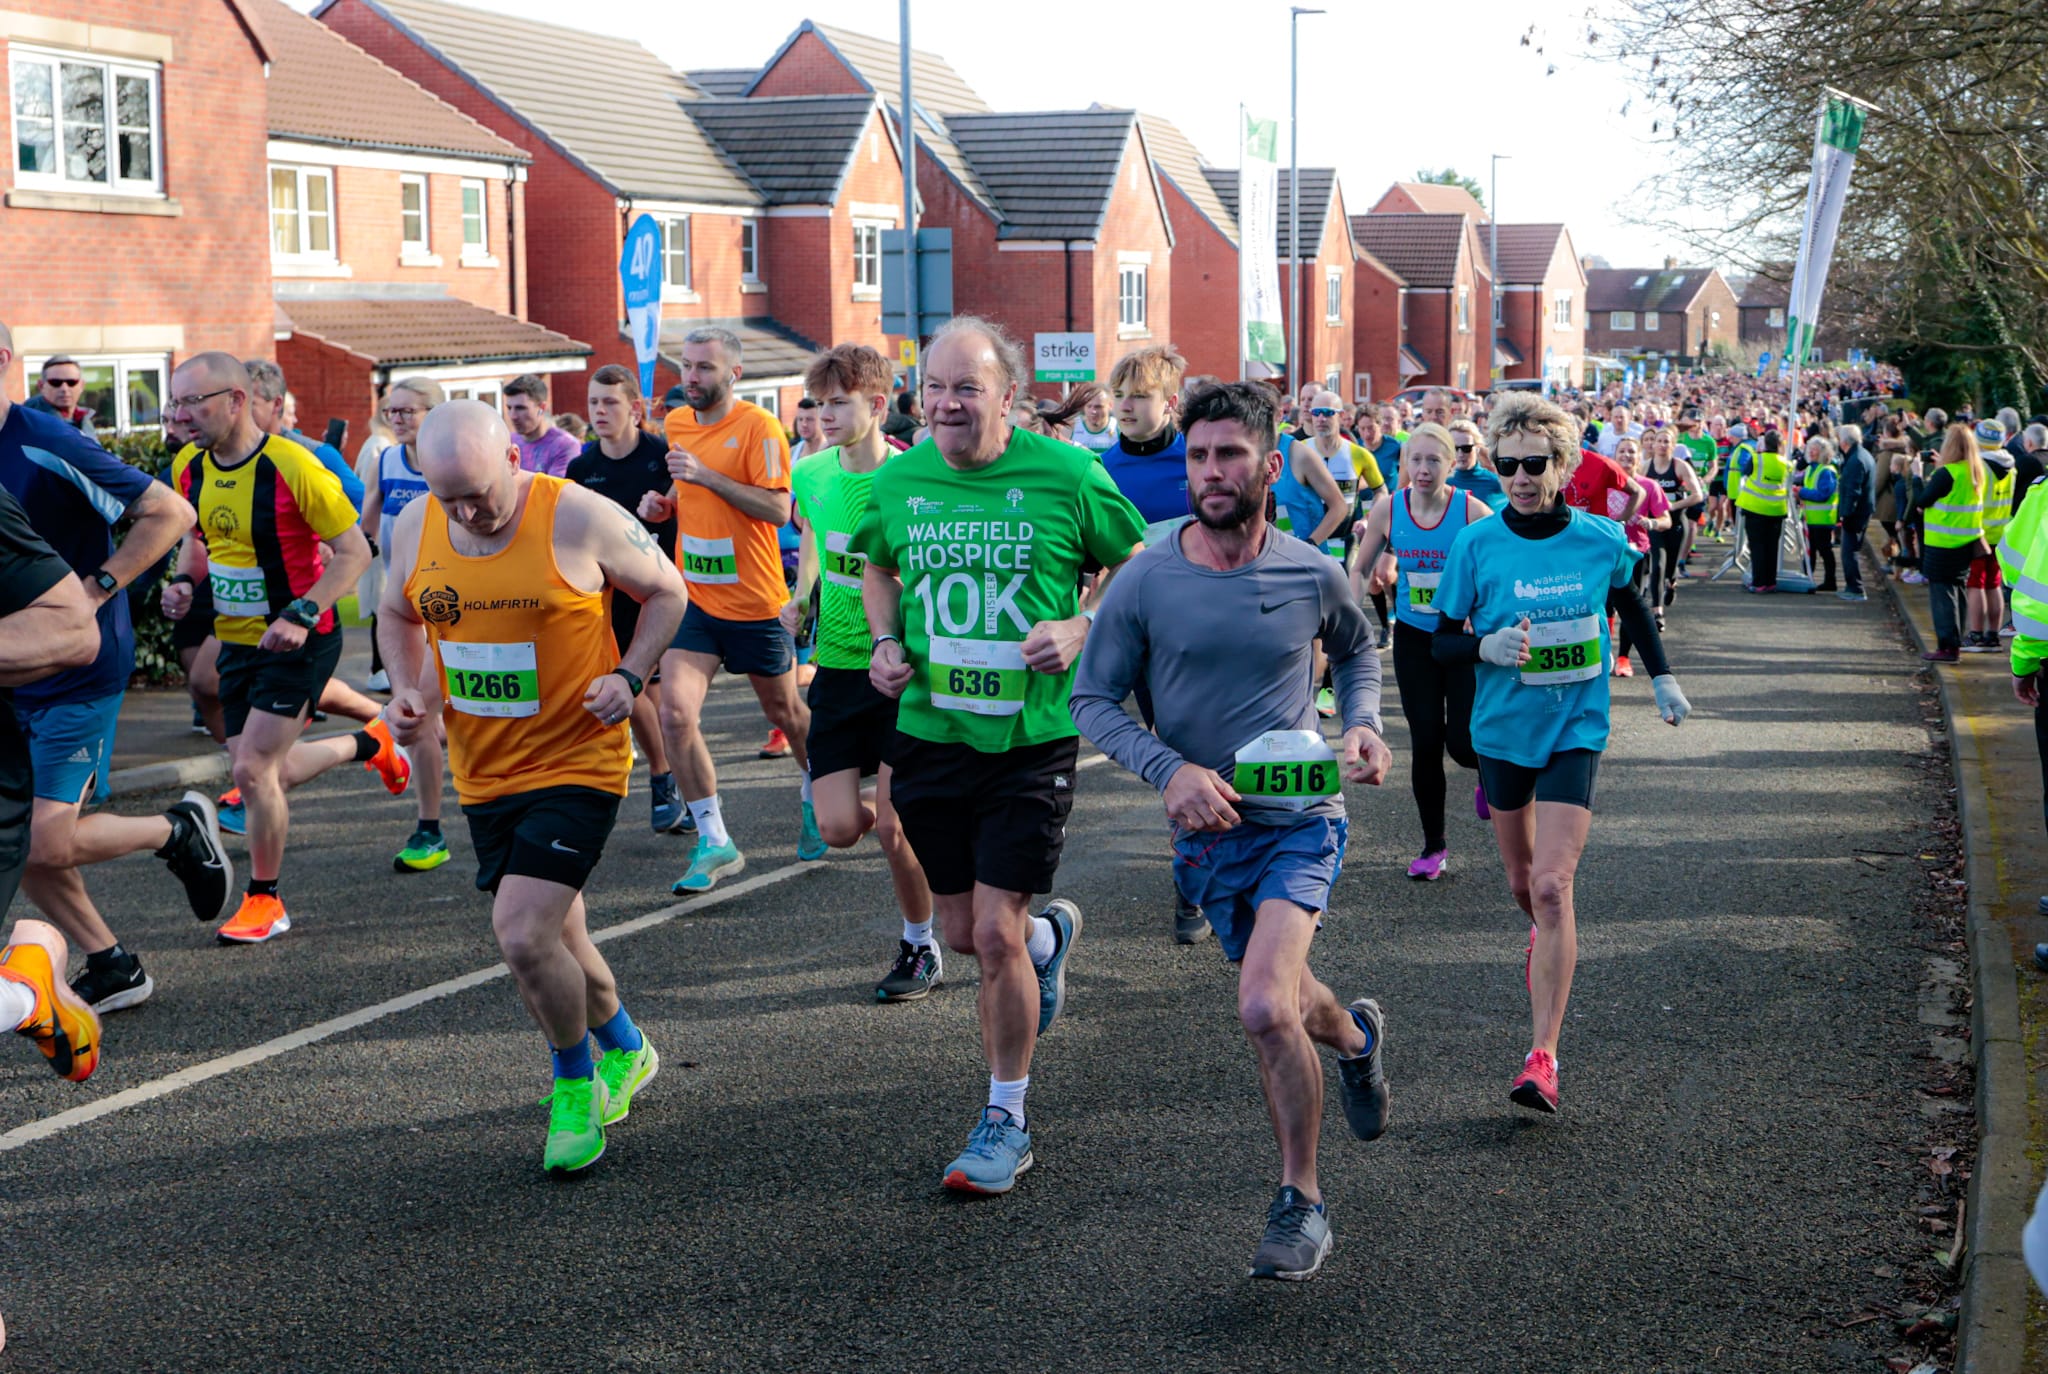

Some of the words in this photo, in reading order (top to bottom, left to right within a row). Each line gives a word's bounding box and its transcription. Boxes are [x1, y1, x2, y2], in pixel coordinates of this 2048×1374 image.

[1041, 341, 1089, 358] strike
[1045, 372, 1061, 380] FOR
[1063, 372, 1085, 380] SALE
[907, 521, 1034, 542] WAKEFIELD
[687, 554, 724, 573] 1471
[908, 543, 1032, 570] HOSPICE
[1397, 549, 1447, 560] BARNSL
[1534, 572, 1582, 585] wakefield
[210, 577, 265, 601] 2245
[1417, 588, 1435, 604] 13
[1535, 582, 1583, 596] hospice
[463, 598, 540, 611] HOLMFIRTH
[915, 572, 1033, 636] 10K
[986, 575, 997, 631] FINISHER
[1516, 604, 1587, 620] Wakefield
[1539, 645, 1586, 670] 358
[455, 671, 521, 699] 1266
[949, 668, 1001, 697] 636
[1253, 763, 1326, 793] 1516
